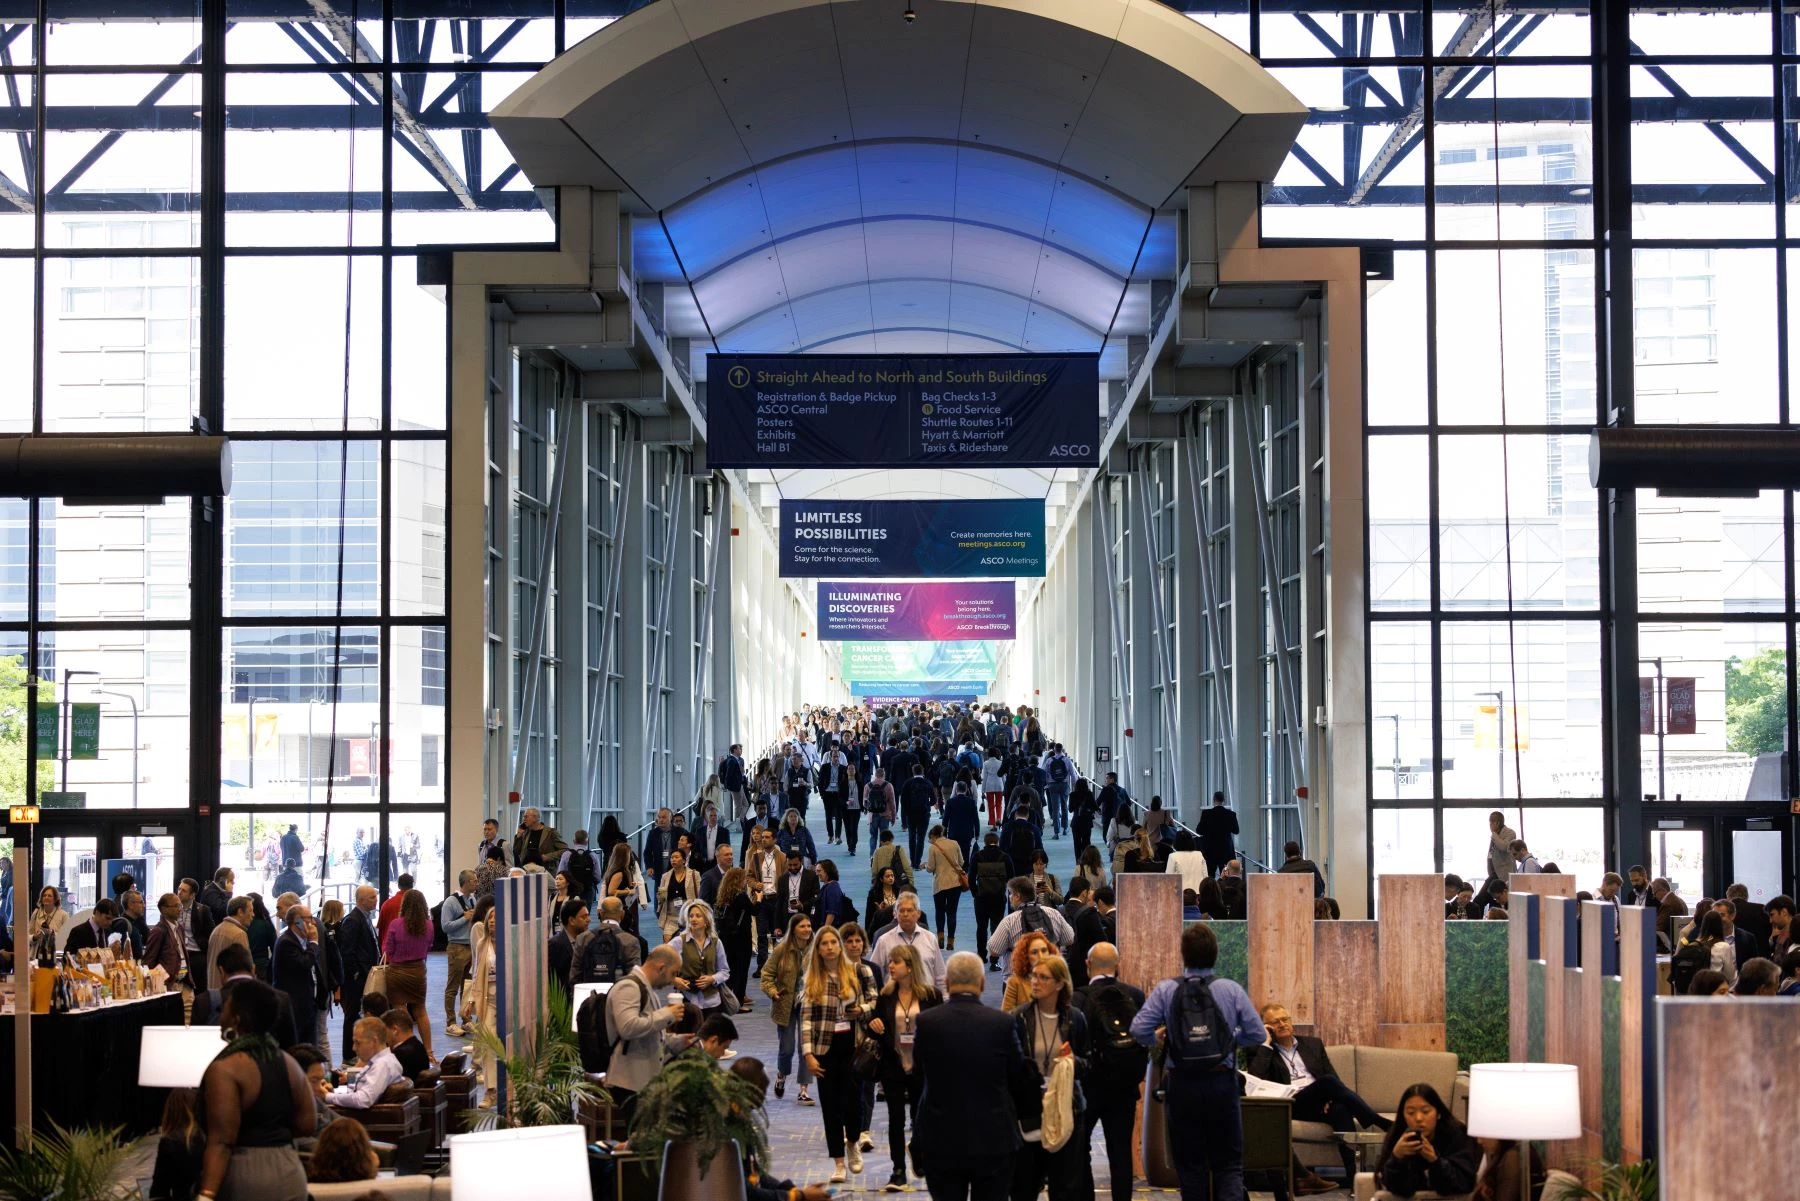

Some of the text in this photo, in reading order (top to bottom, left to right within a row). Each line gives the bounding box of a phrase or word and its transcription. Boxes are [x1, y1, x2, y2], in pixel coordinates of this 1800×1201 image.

[757, 370, 1047, 385] Straight Ahead to North and South Buildings
[757, 392, 896, 404] Registration & Badge Pickup
[922, 392, 996, 403] Bag Checks 1-3
[757, 405, 828, 414] ASCO Central
[937, 405, 1001, 414] Food Service
[757, 418, 793, 427] Posters
[922, 417, 1013, 427] Shuttle Routes 1-11
[757, 430, 796, 440] Exhibits
[922, 430, 1004, 442] Hyatt & Marriott
[757, 443, 790, 453] Hall B1
[922, 443, 1008, 452] Taxis & Rideshare
[1049, 444, 1090, 456] ASCO
[795, 512, 862, 524] LIMITLESS
[795, 528, 887, 539] POSSIBILITIES
[958, 540, 1025, 549] meetings.asco.org
[818, 546, 829, 554] for
[794, 555, 810, 564] Stay
[1006, 557, 1038, 565] Meetings
[829, 593, 901, 601] ILLUMINATING
[829, 604, 895, 613] DISCOVERIES
[16, 808, 33, 820] EXIT
